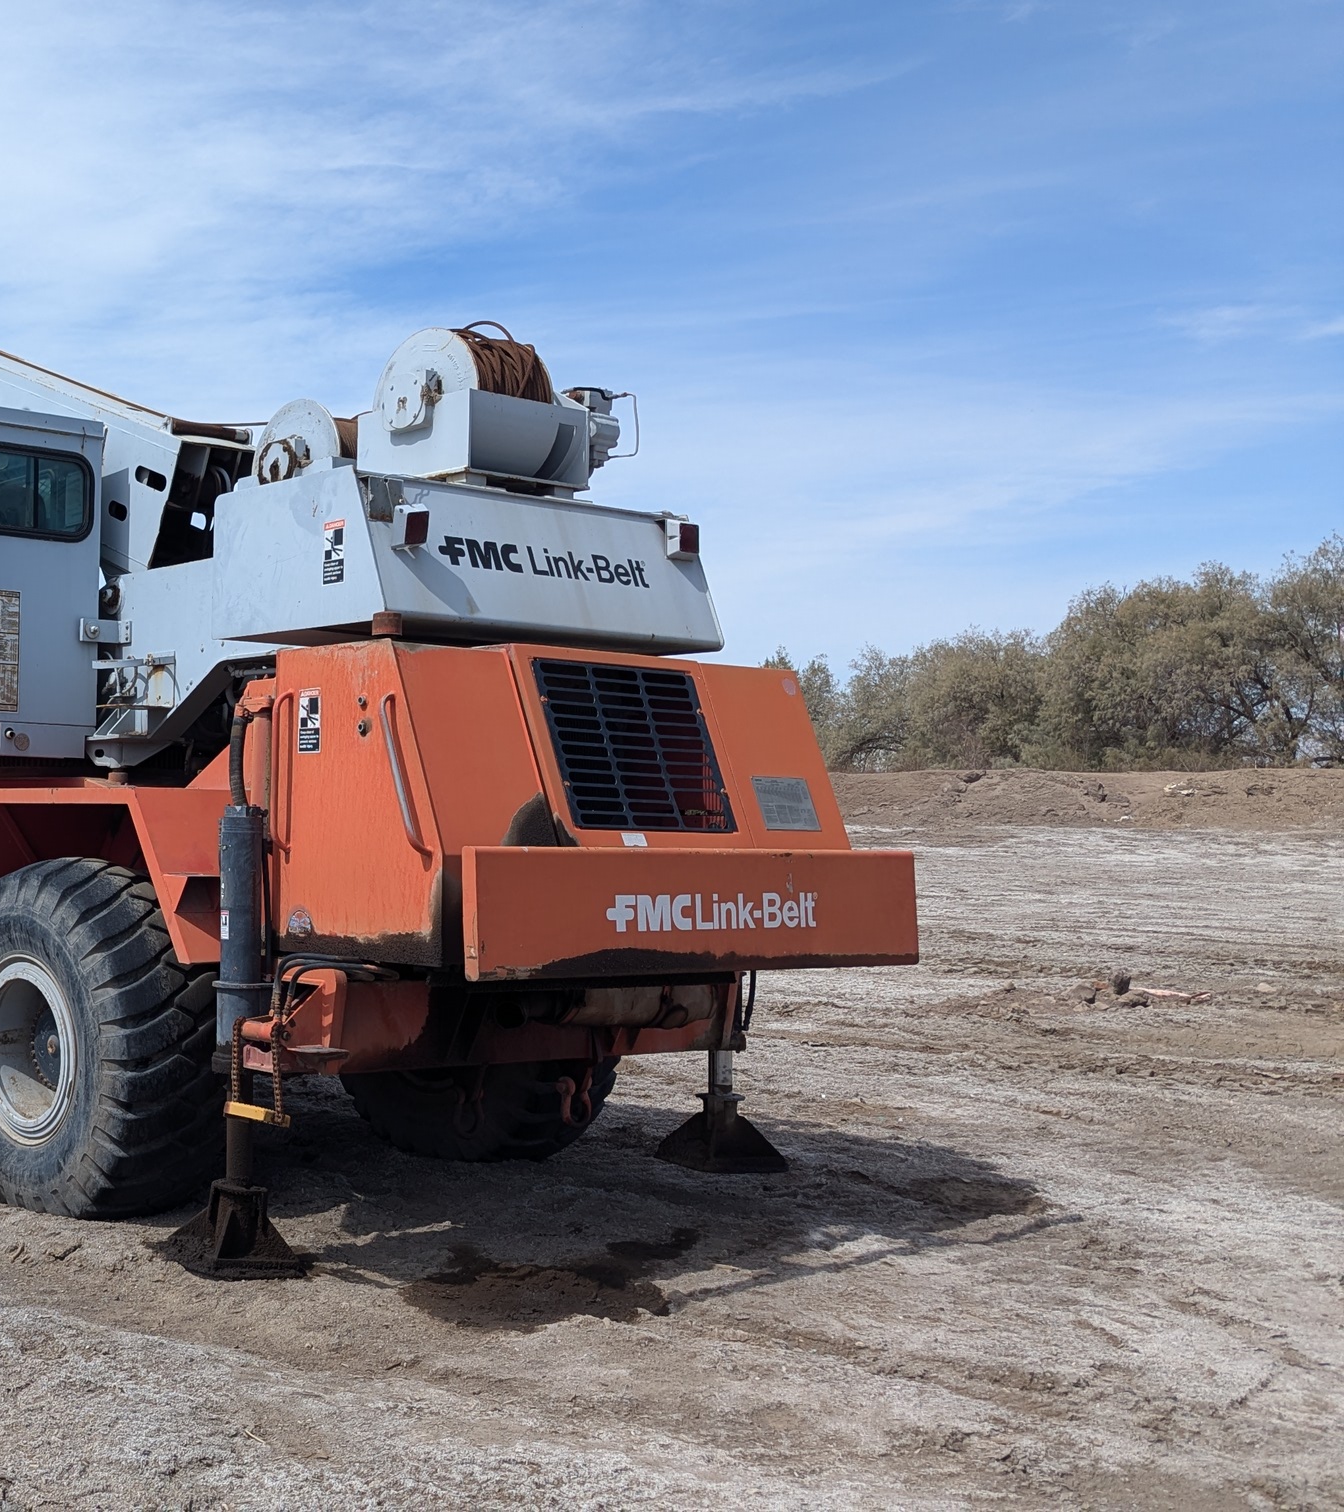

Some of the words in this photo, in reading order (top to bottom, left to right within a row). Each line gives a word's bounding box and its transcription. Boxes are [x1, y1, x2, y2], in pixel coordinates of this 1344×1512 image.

[438, 536, 523, 573] FMC
[526, 546, 649, 588] Link-Belt
[606, 894, 693, 932] FMC
[696, 892, 816, 930] Link-Belt
